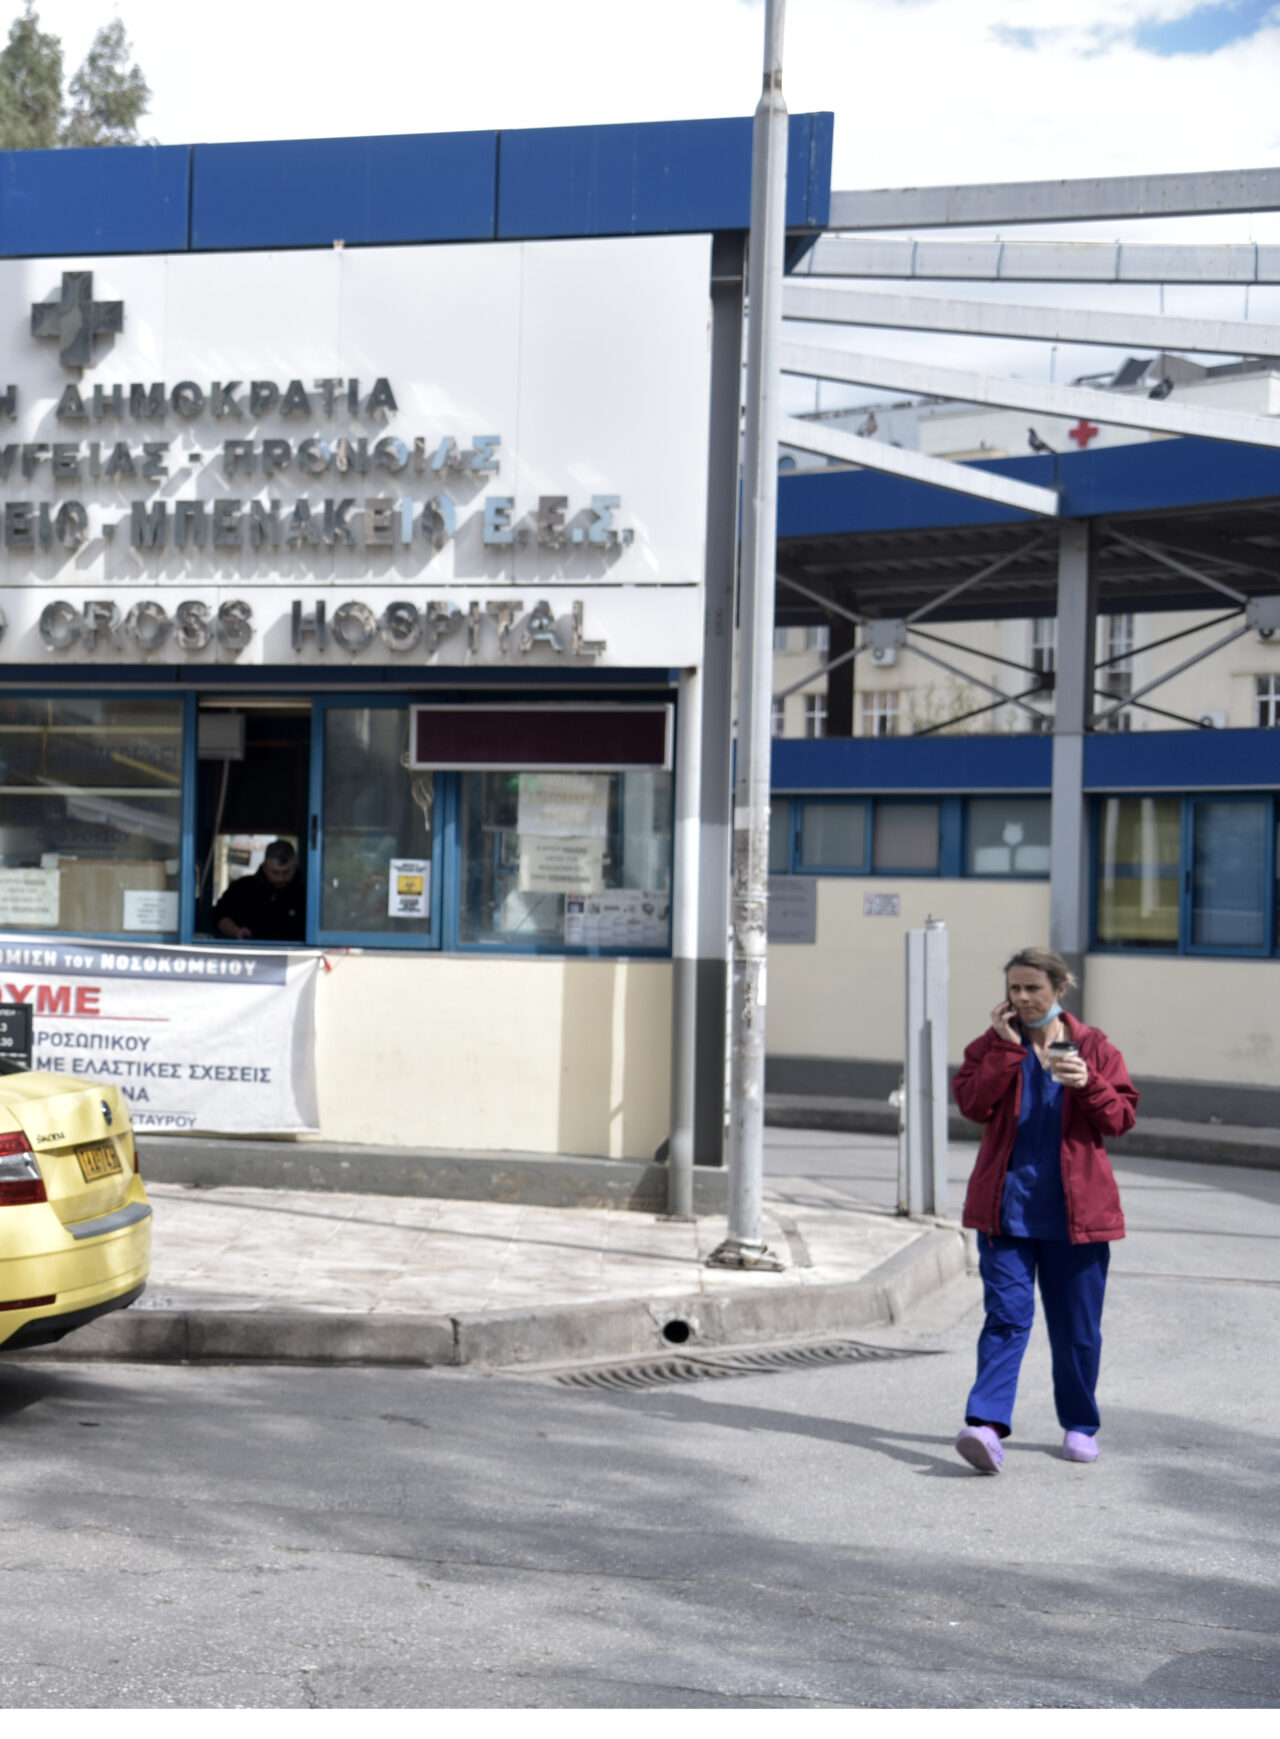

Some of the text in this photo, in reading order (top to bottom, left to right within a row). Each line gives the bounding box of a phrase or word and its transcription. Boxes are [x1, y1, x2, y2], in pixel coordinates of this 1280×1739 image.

[57, 378, 398, 420] ΔΗΜΟΚΡΑΤΙΑ
[224, 435, 501, 477] ΠΡΟΝΟΙΑΣ
[130, 496, 457, 550] ΜΠΕΝΑΚΕΙΟ
[39, 600, 255, 650] CROSS
[291, 599, 606, 654] HOSPITAL
[101, 953, 256, 977] ΝΟΣΟΚΟΜΕΙΟΥ
[32, 1031, 150, 1052] ΡΟΣΩΠΙΚΟΥ
[36, 1056, 271, 1083] ΜΕ ΕΛΑΣΤΙΚΕΣ ΣΧΕΣΕΙΣ
